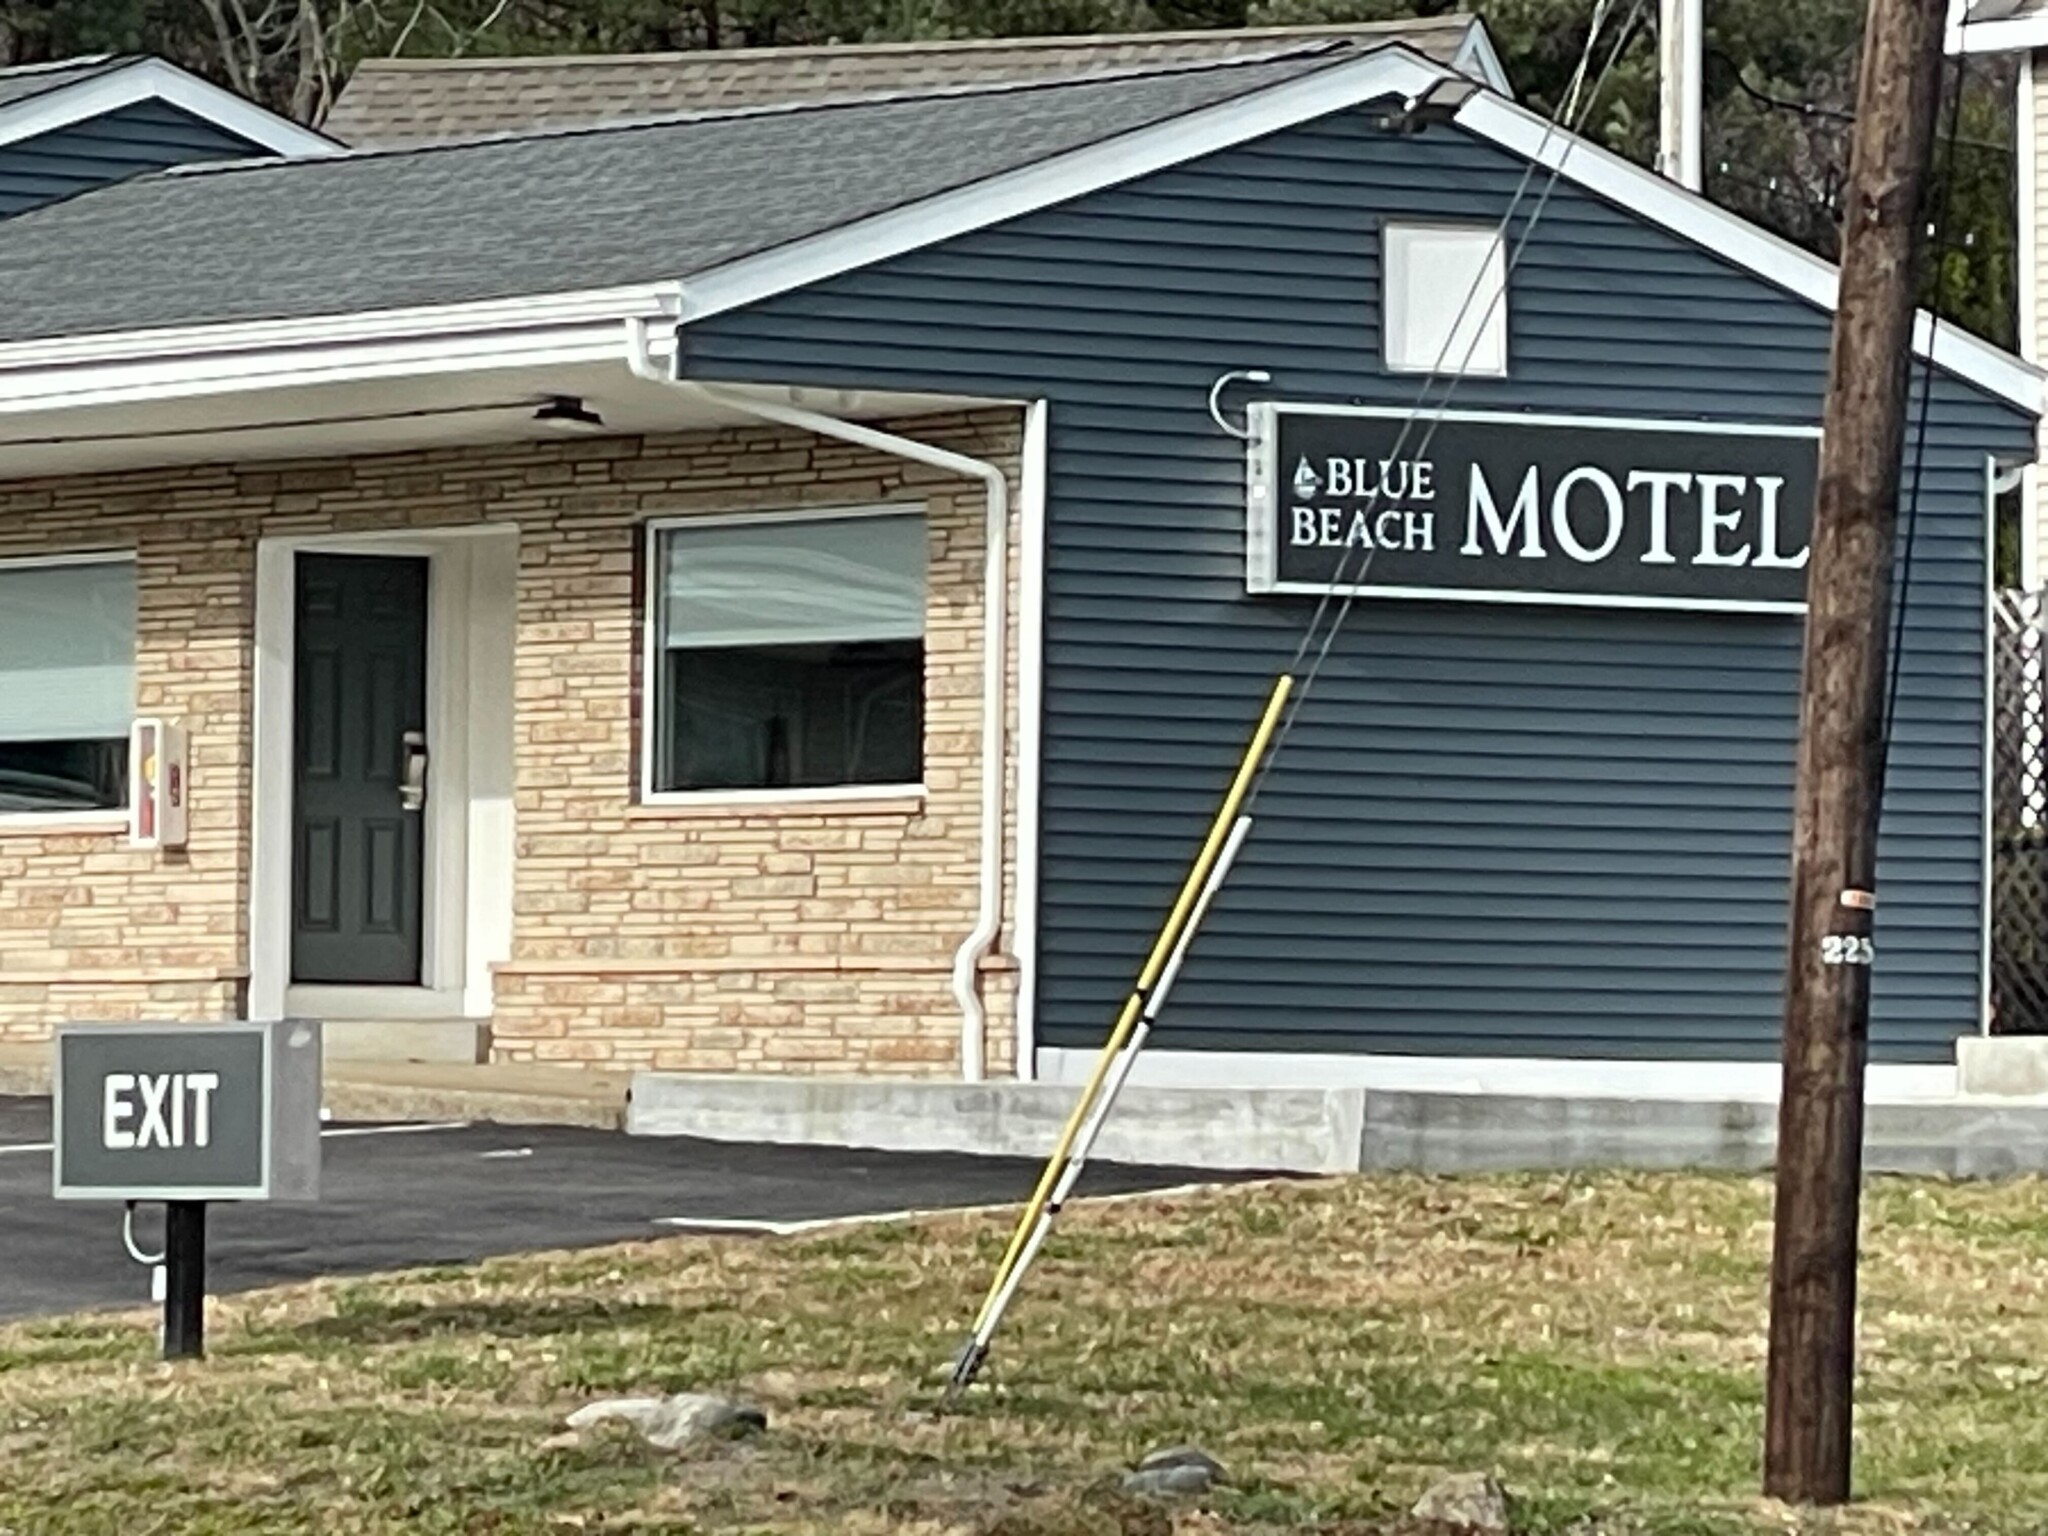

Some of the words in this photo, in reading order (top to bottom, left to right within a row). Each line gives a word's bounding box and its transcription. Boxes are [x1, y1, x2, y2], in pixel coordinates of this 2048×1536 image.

[1325, 457, 1436, 499] BLUE
[1290, 506, 1434, 551] BEACH
[1459, 462, 1810, 569] MOTEL
[1821, 935, 1874, 965] 225
[103, 1073, 219, 1149] EXIT
